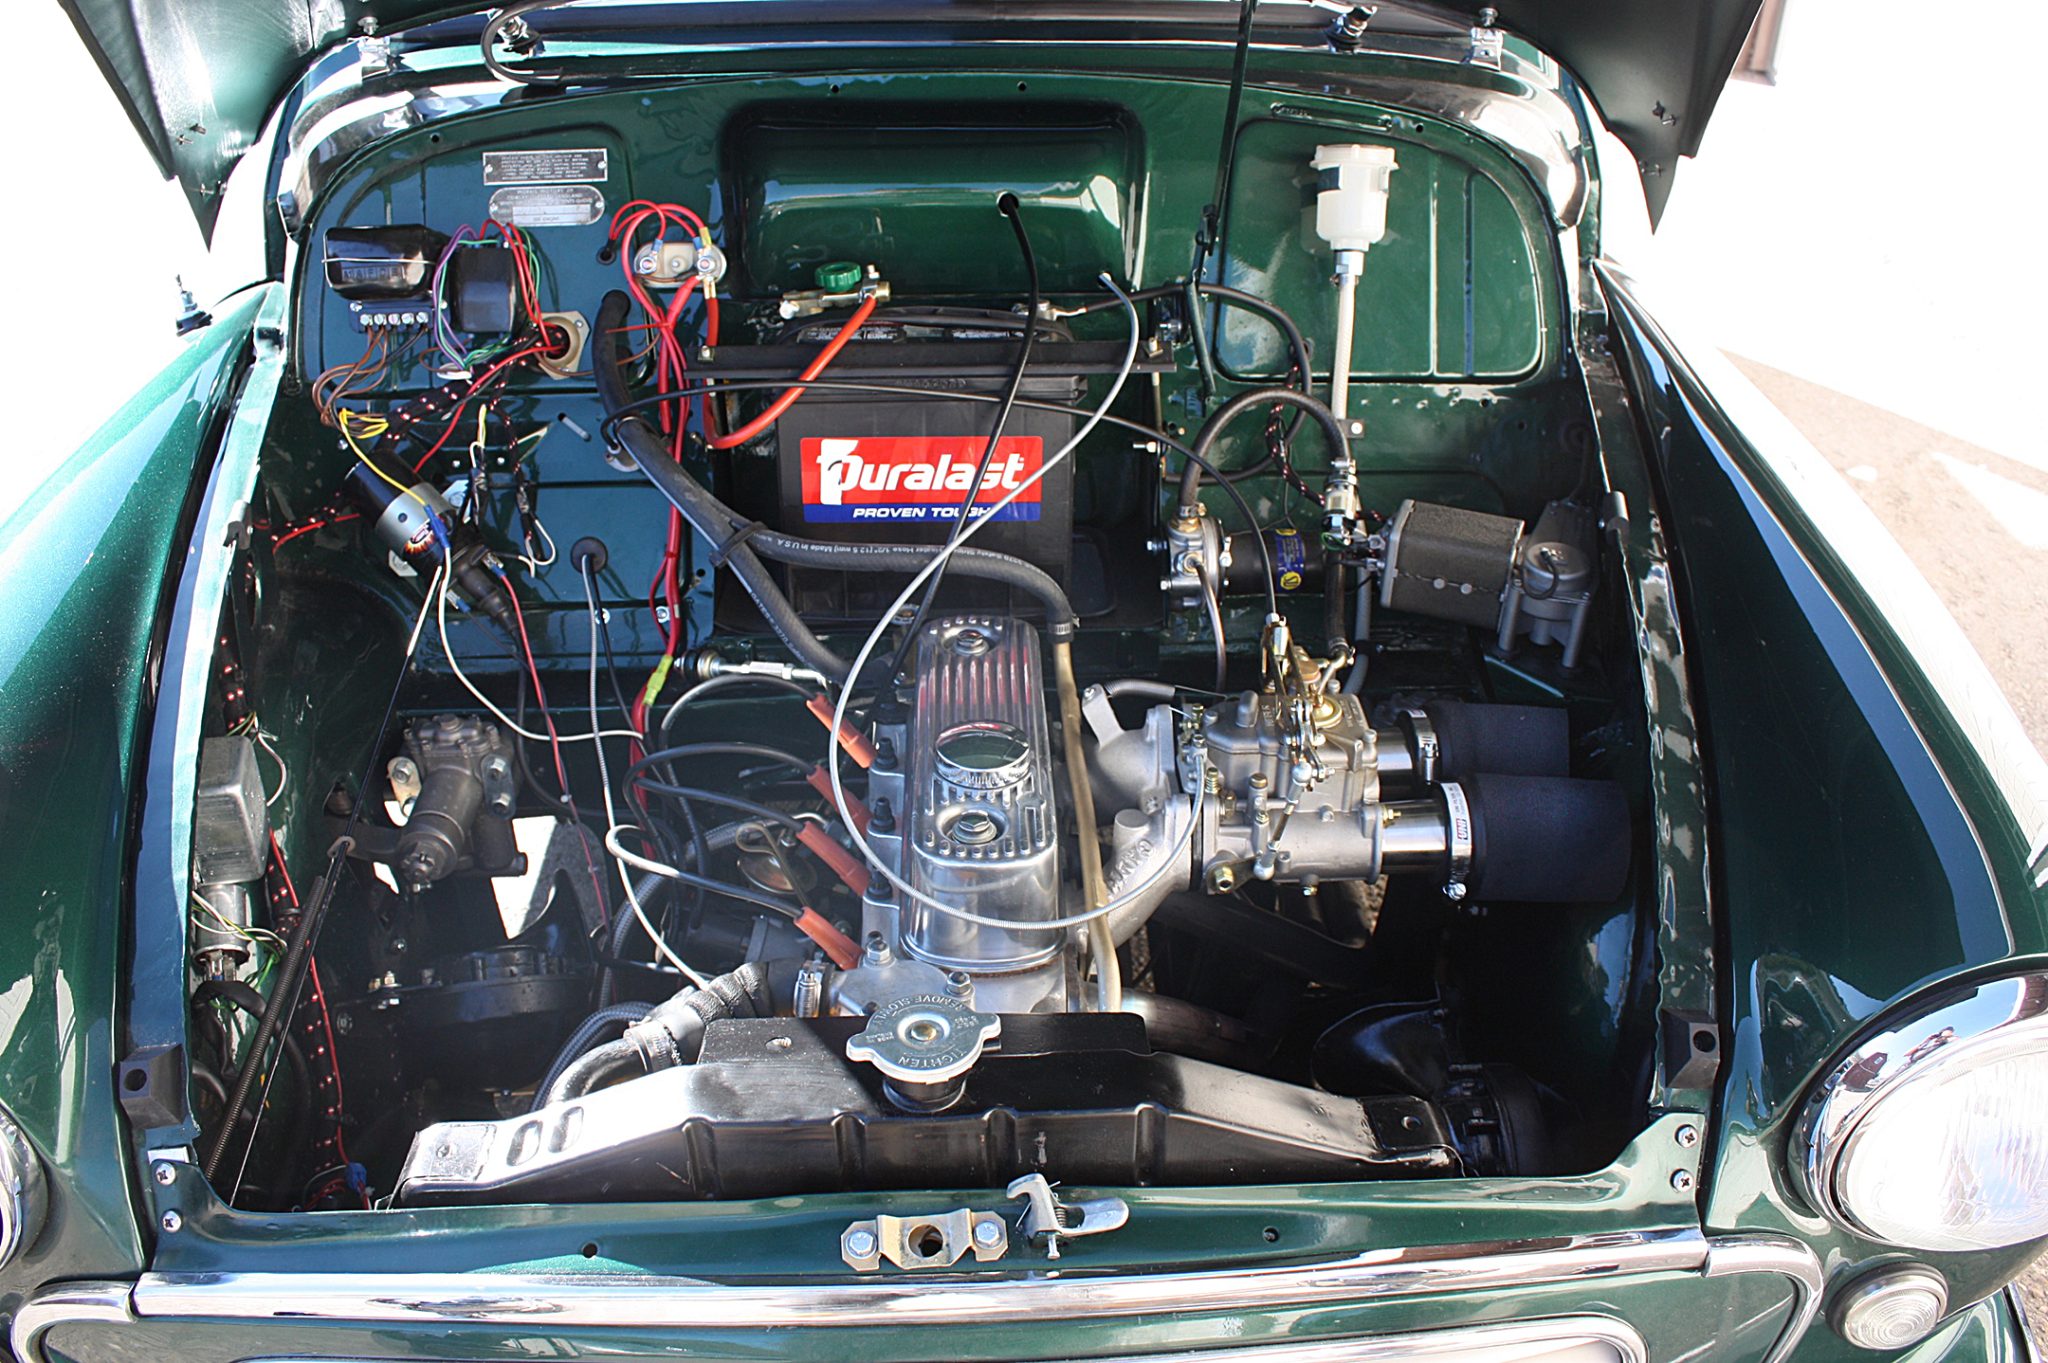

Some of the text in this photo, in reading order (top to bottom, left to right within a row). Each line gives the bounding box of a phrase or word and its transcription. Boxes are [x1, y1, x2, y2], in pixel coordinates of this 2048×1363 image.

[816, 439, 1025, 505] Duralast
[853, 507, 926, 518] PROVEN
[800, 543, 808, 551] in
[810, 544, 833, 553] Made
[872, 994, 966, 1025] REMOVE SLOWLY
[898, 1049, 968, 1068] TIGHTEN
